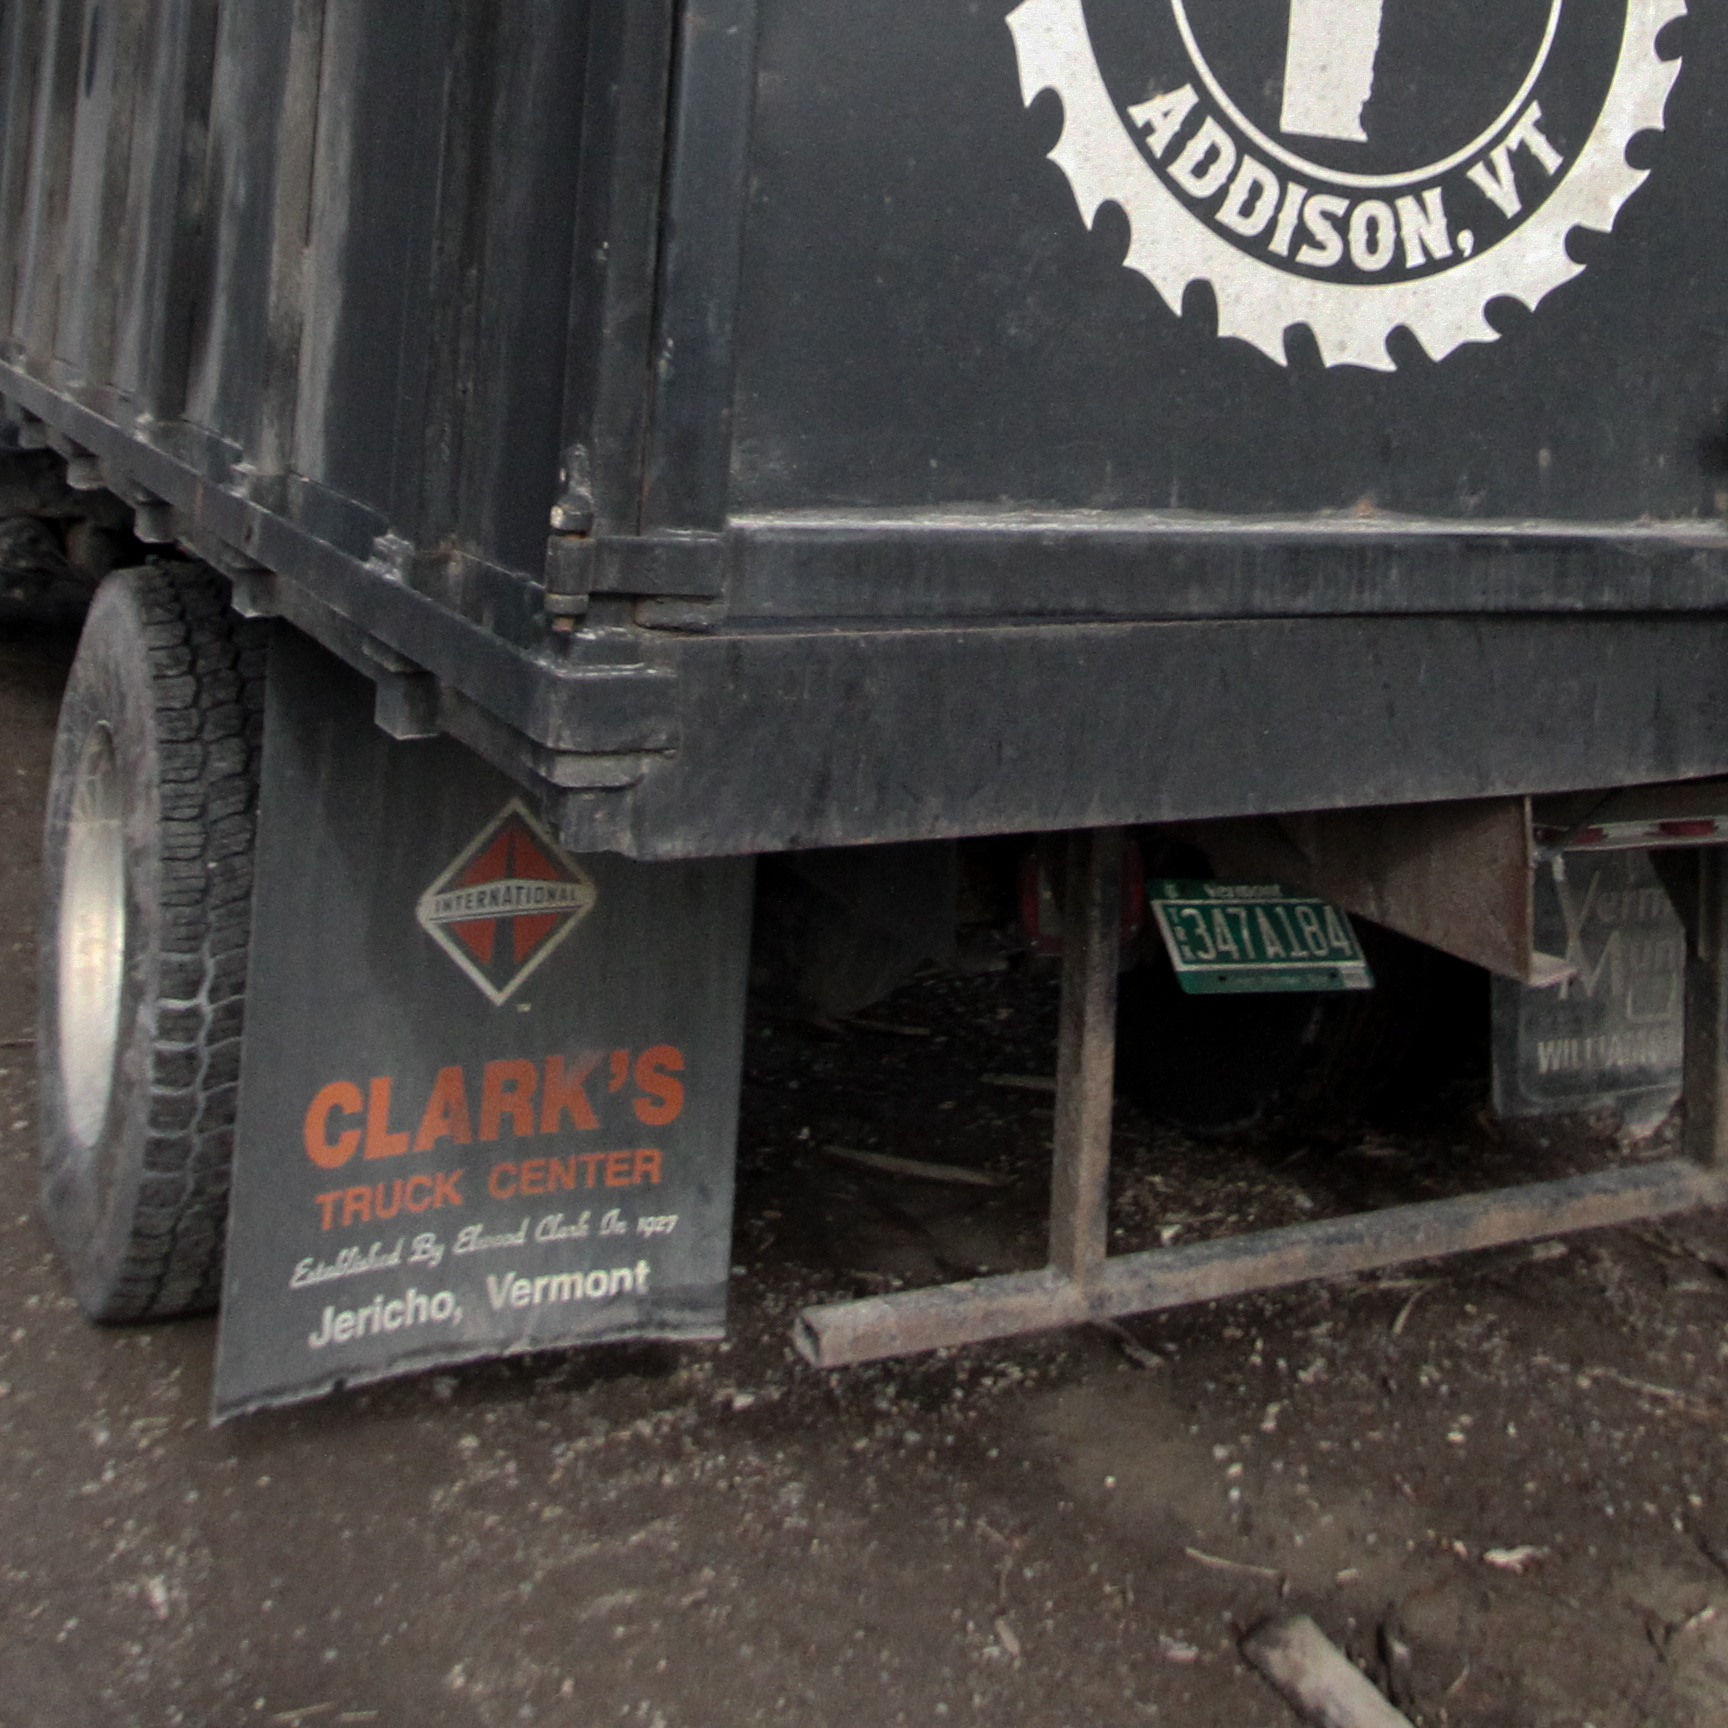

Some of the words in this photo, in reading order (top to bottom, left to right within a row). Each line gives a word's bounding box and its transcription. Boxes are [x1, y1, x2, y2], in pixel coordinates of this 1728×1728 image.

[1127, 83, 1478, 273] ADDISON,
[1468, 101, 1563, 220] VT
[434, 884, 578, 914] INTERNATIONAL
[1179, 905, 1355, 960] 347A184
[303, 1044, 686, 1169] CLARK'S
[315, 1169, 463, 1231] TRUCK
[488, 1149, 662, 1200] CENTER
[289, 1237, 404, 1289] Established
[407, 1232, 446, 1268] By
[307, 1288, 464, 1349] Jericho,
[486, 1260, 651, 1311] Vermont
